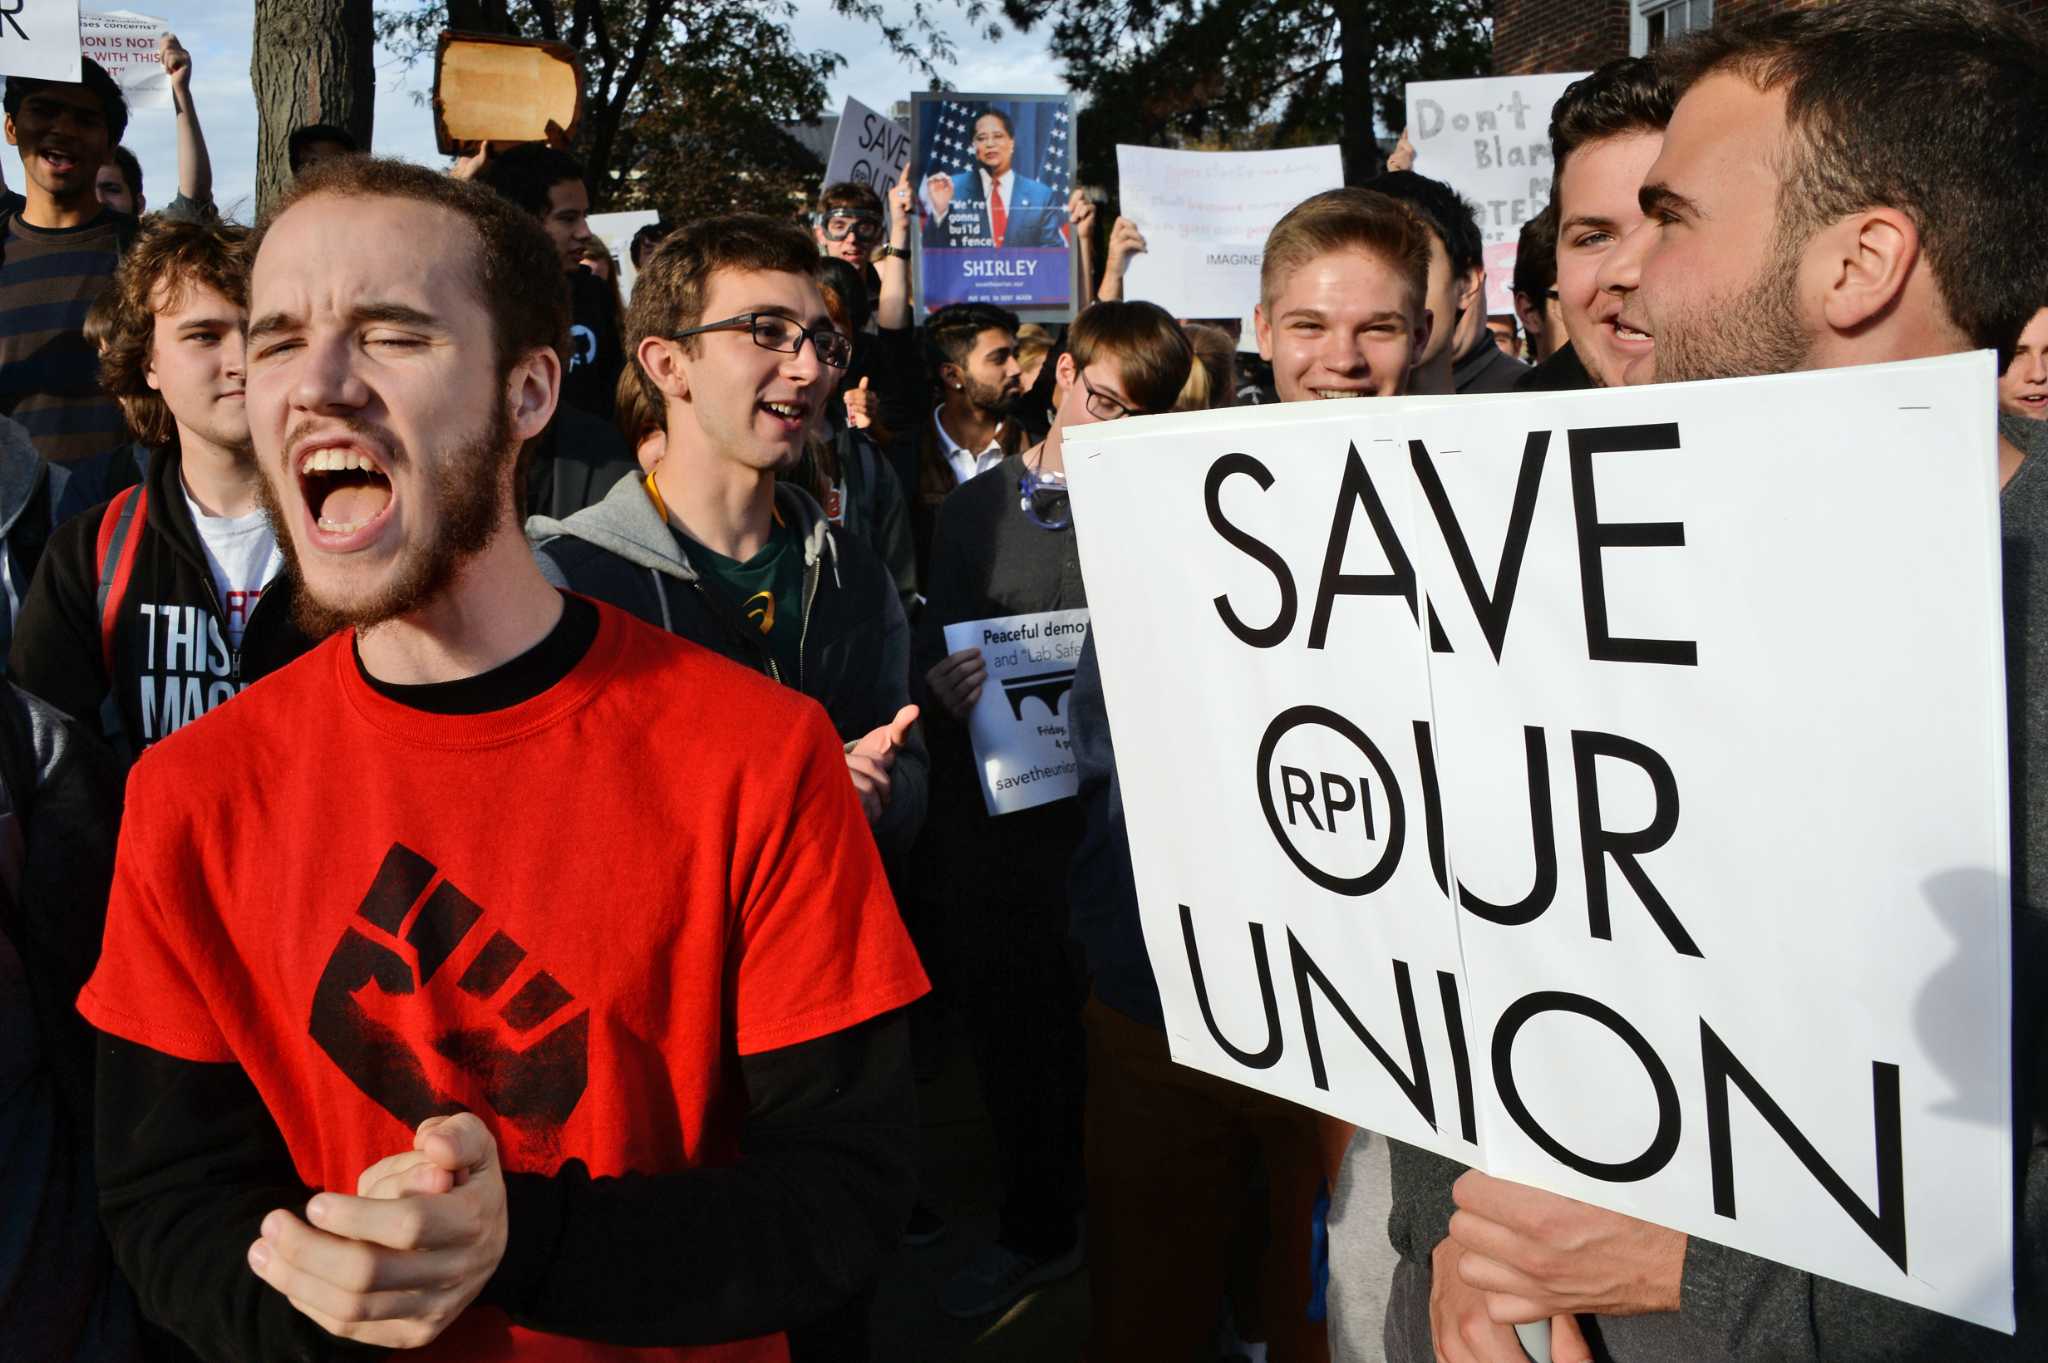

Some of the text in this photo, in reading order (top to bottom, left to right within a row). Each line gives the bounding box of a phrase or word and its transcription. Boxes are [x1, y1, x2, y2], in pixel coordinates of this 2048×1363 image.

[111, 38, 122, 47] IS
[127, 38, 155, 48] NOT
[94, 52, 128, 62] WITH
[133, 53, 160, 63] THIS
[1416, 90, 1532, 140] Don't
[858, 114, 911, 172] SAVE
[948, 213, 980, 223] gonna
[948, 224, 981, 235] build
[949, 239, 957, 247] a
[962, 259, 1038, 277] SHIRLEY
[1206, 253, 1262, 266] IMAGINE
[1203, 421, 1699, 667] SAVE
[140, 603, 231, 677] THIS
[983, 623, 1040, 646] Peaceful
[994, 649, 1018, 668] and
[1279, 764, 1376, 842] RPI
[1255, 704, 1706, 959] OUR
[1177, 903, 1909, 1277] UNION
